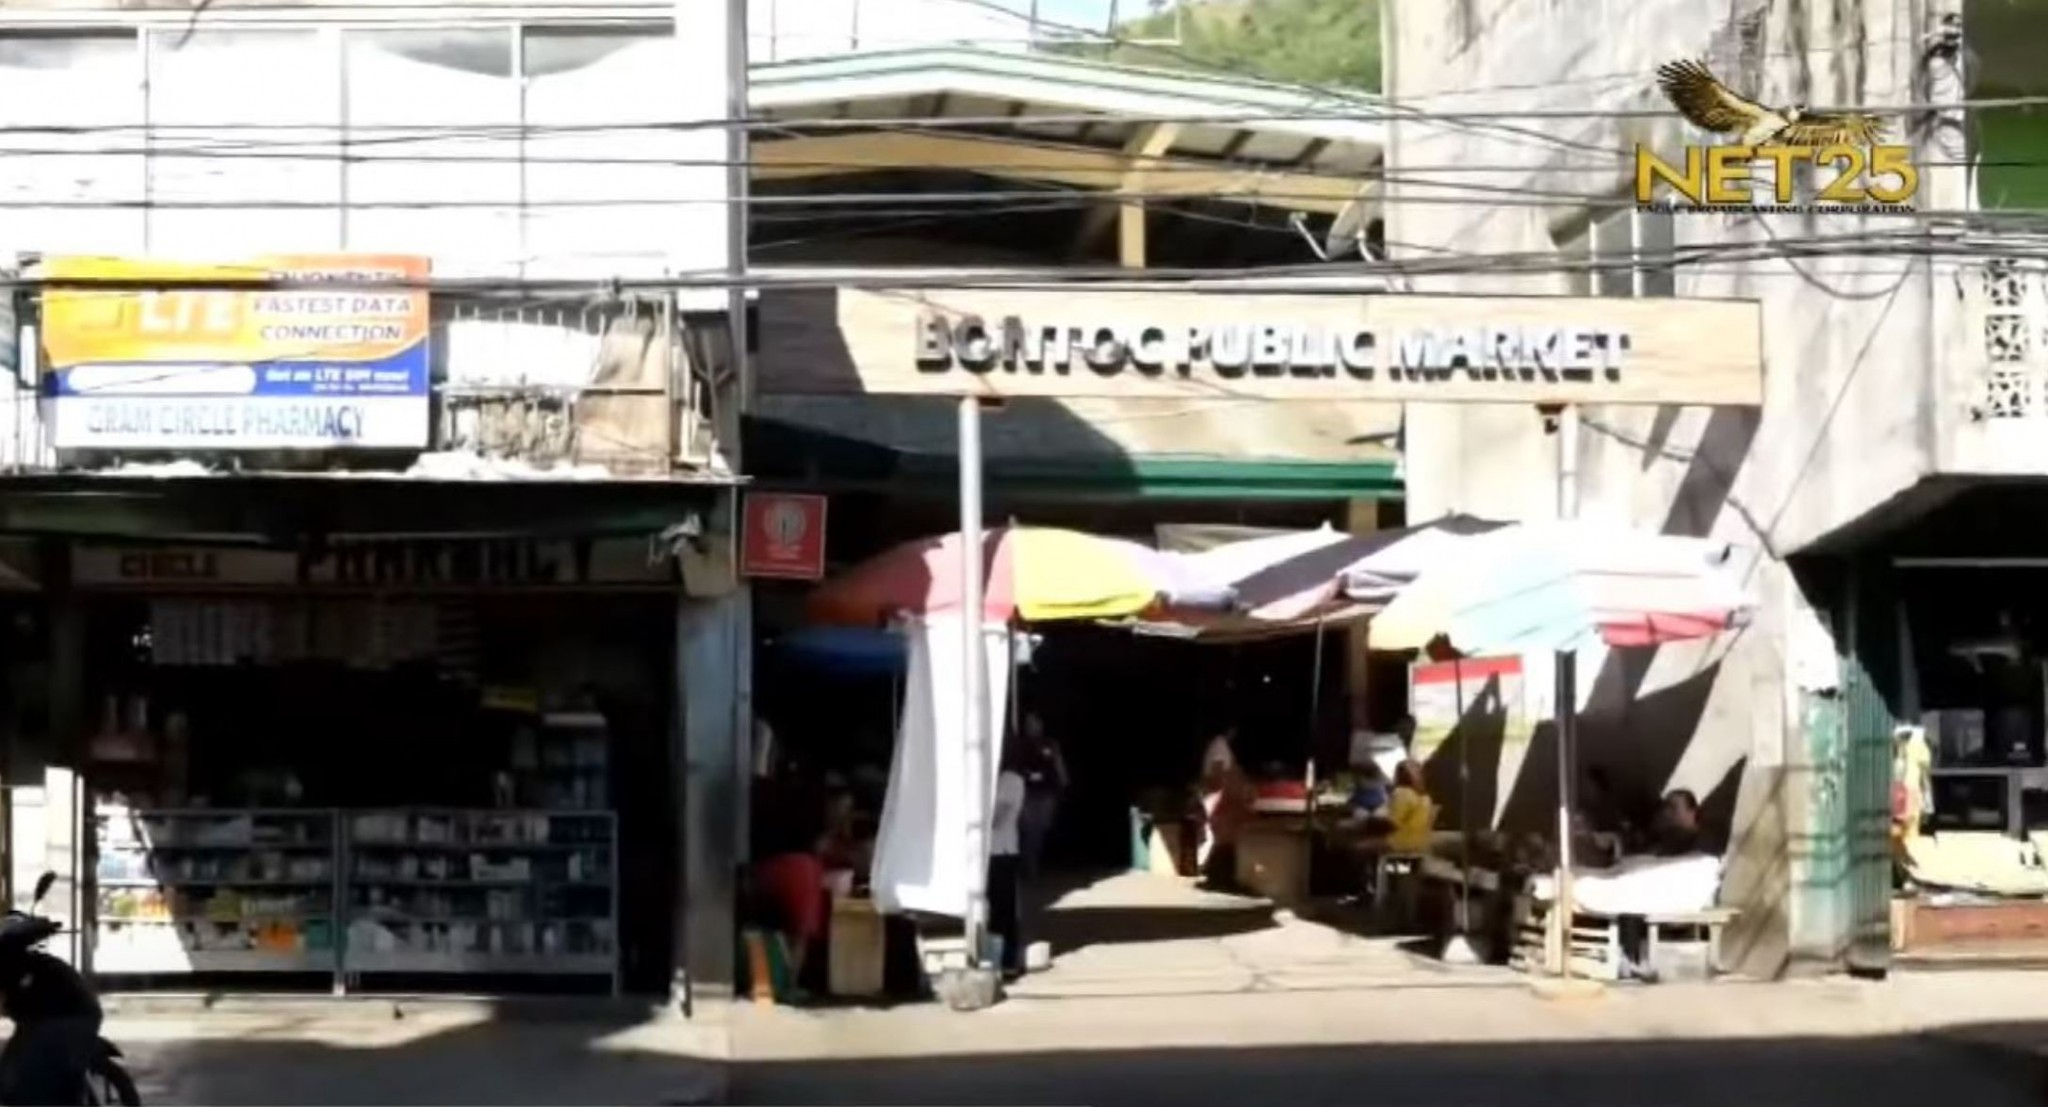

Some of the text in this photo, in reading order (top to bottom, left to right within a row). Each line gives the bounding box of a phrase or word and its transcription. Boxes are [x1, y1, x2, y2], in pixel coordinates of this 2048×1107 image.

[254, 297, 411, 314] FASTEST DATA
[259, 324, 401, 341] CONNECTION
[915, 314, 1631, 383] BONTOC PUBLIC MARKET
[159, 403, 238, 437] CIRCLE
[242, 403, 366, 439] PHARMACY
